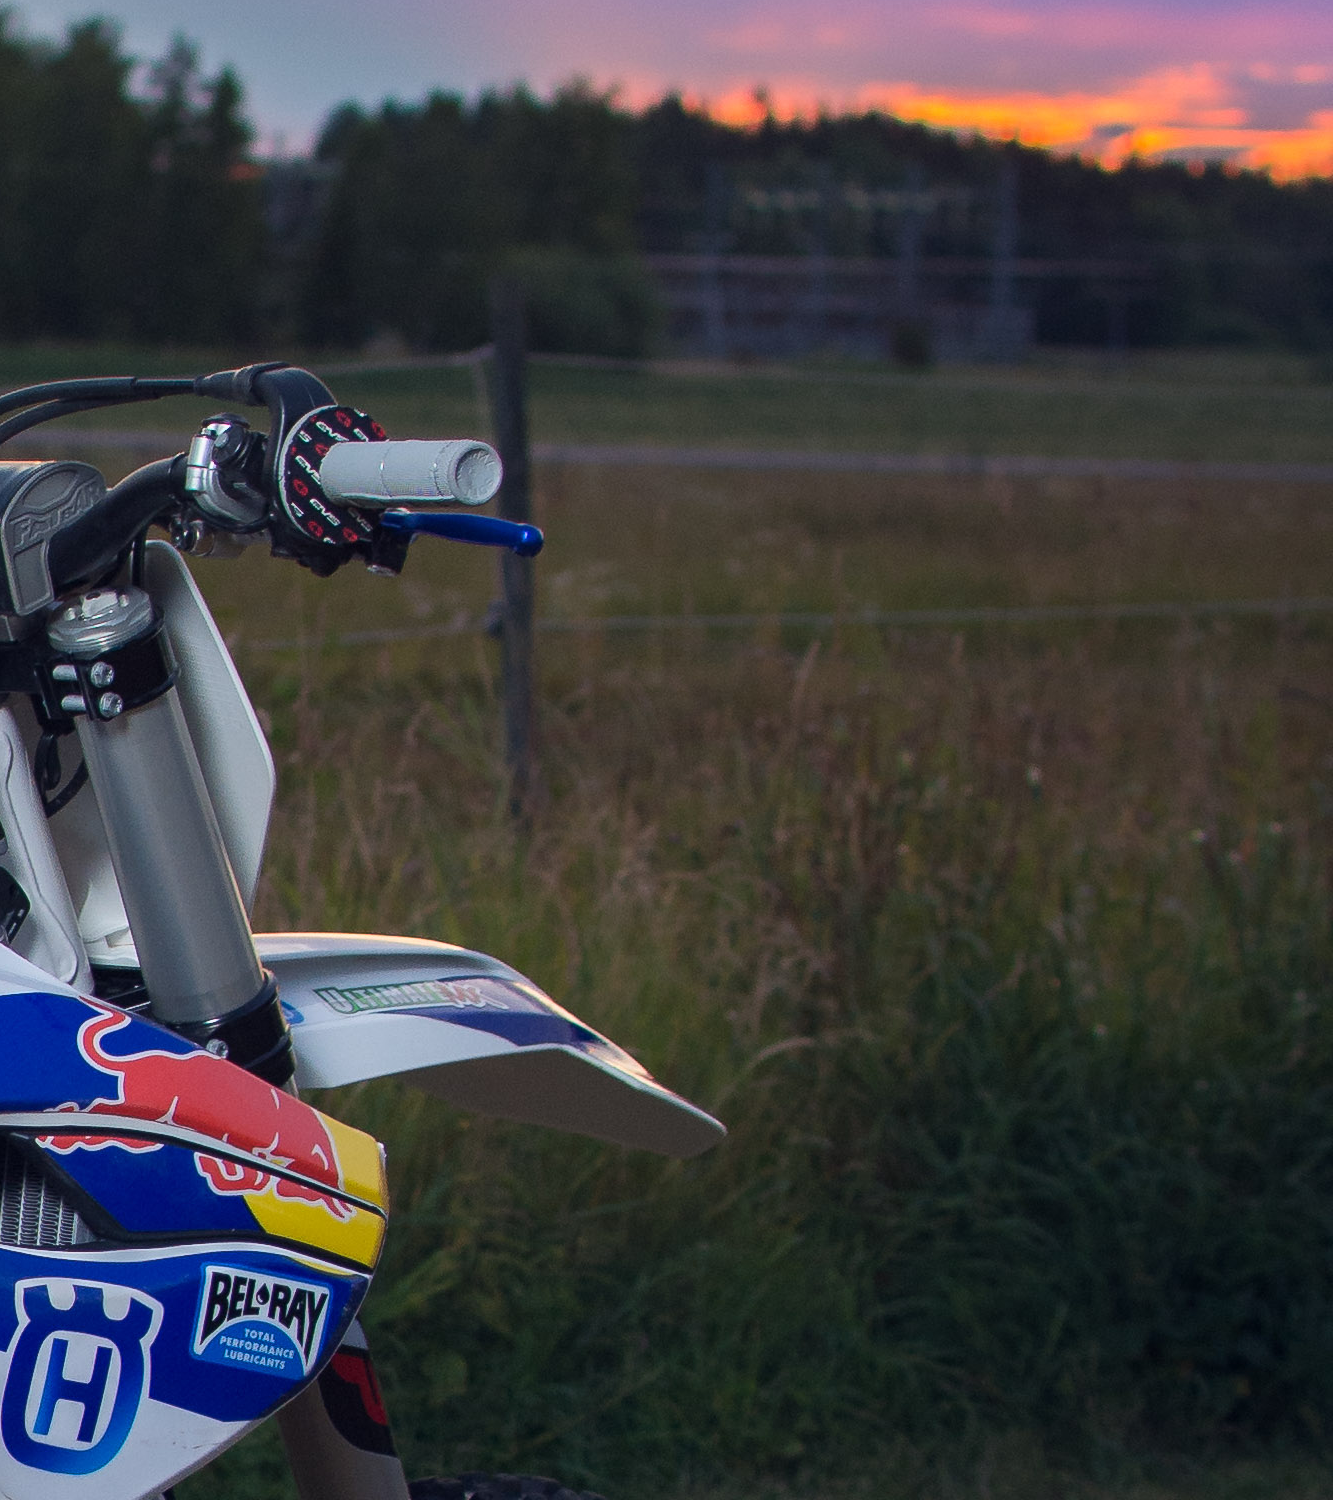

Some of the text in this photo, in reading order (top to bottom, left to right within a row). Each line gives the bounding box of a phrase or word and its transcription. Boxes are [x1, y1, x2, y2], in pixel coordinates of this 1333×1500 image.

[309, 498, 341, 526] EVS
[244, 1328, 276, 1343] TOTAL
[220, 1335, 295, 1360] PERFORMANCE
[224, 1349, 286, 1370] LUBRICANTS
